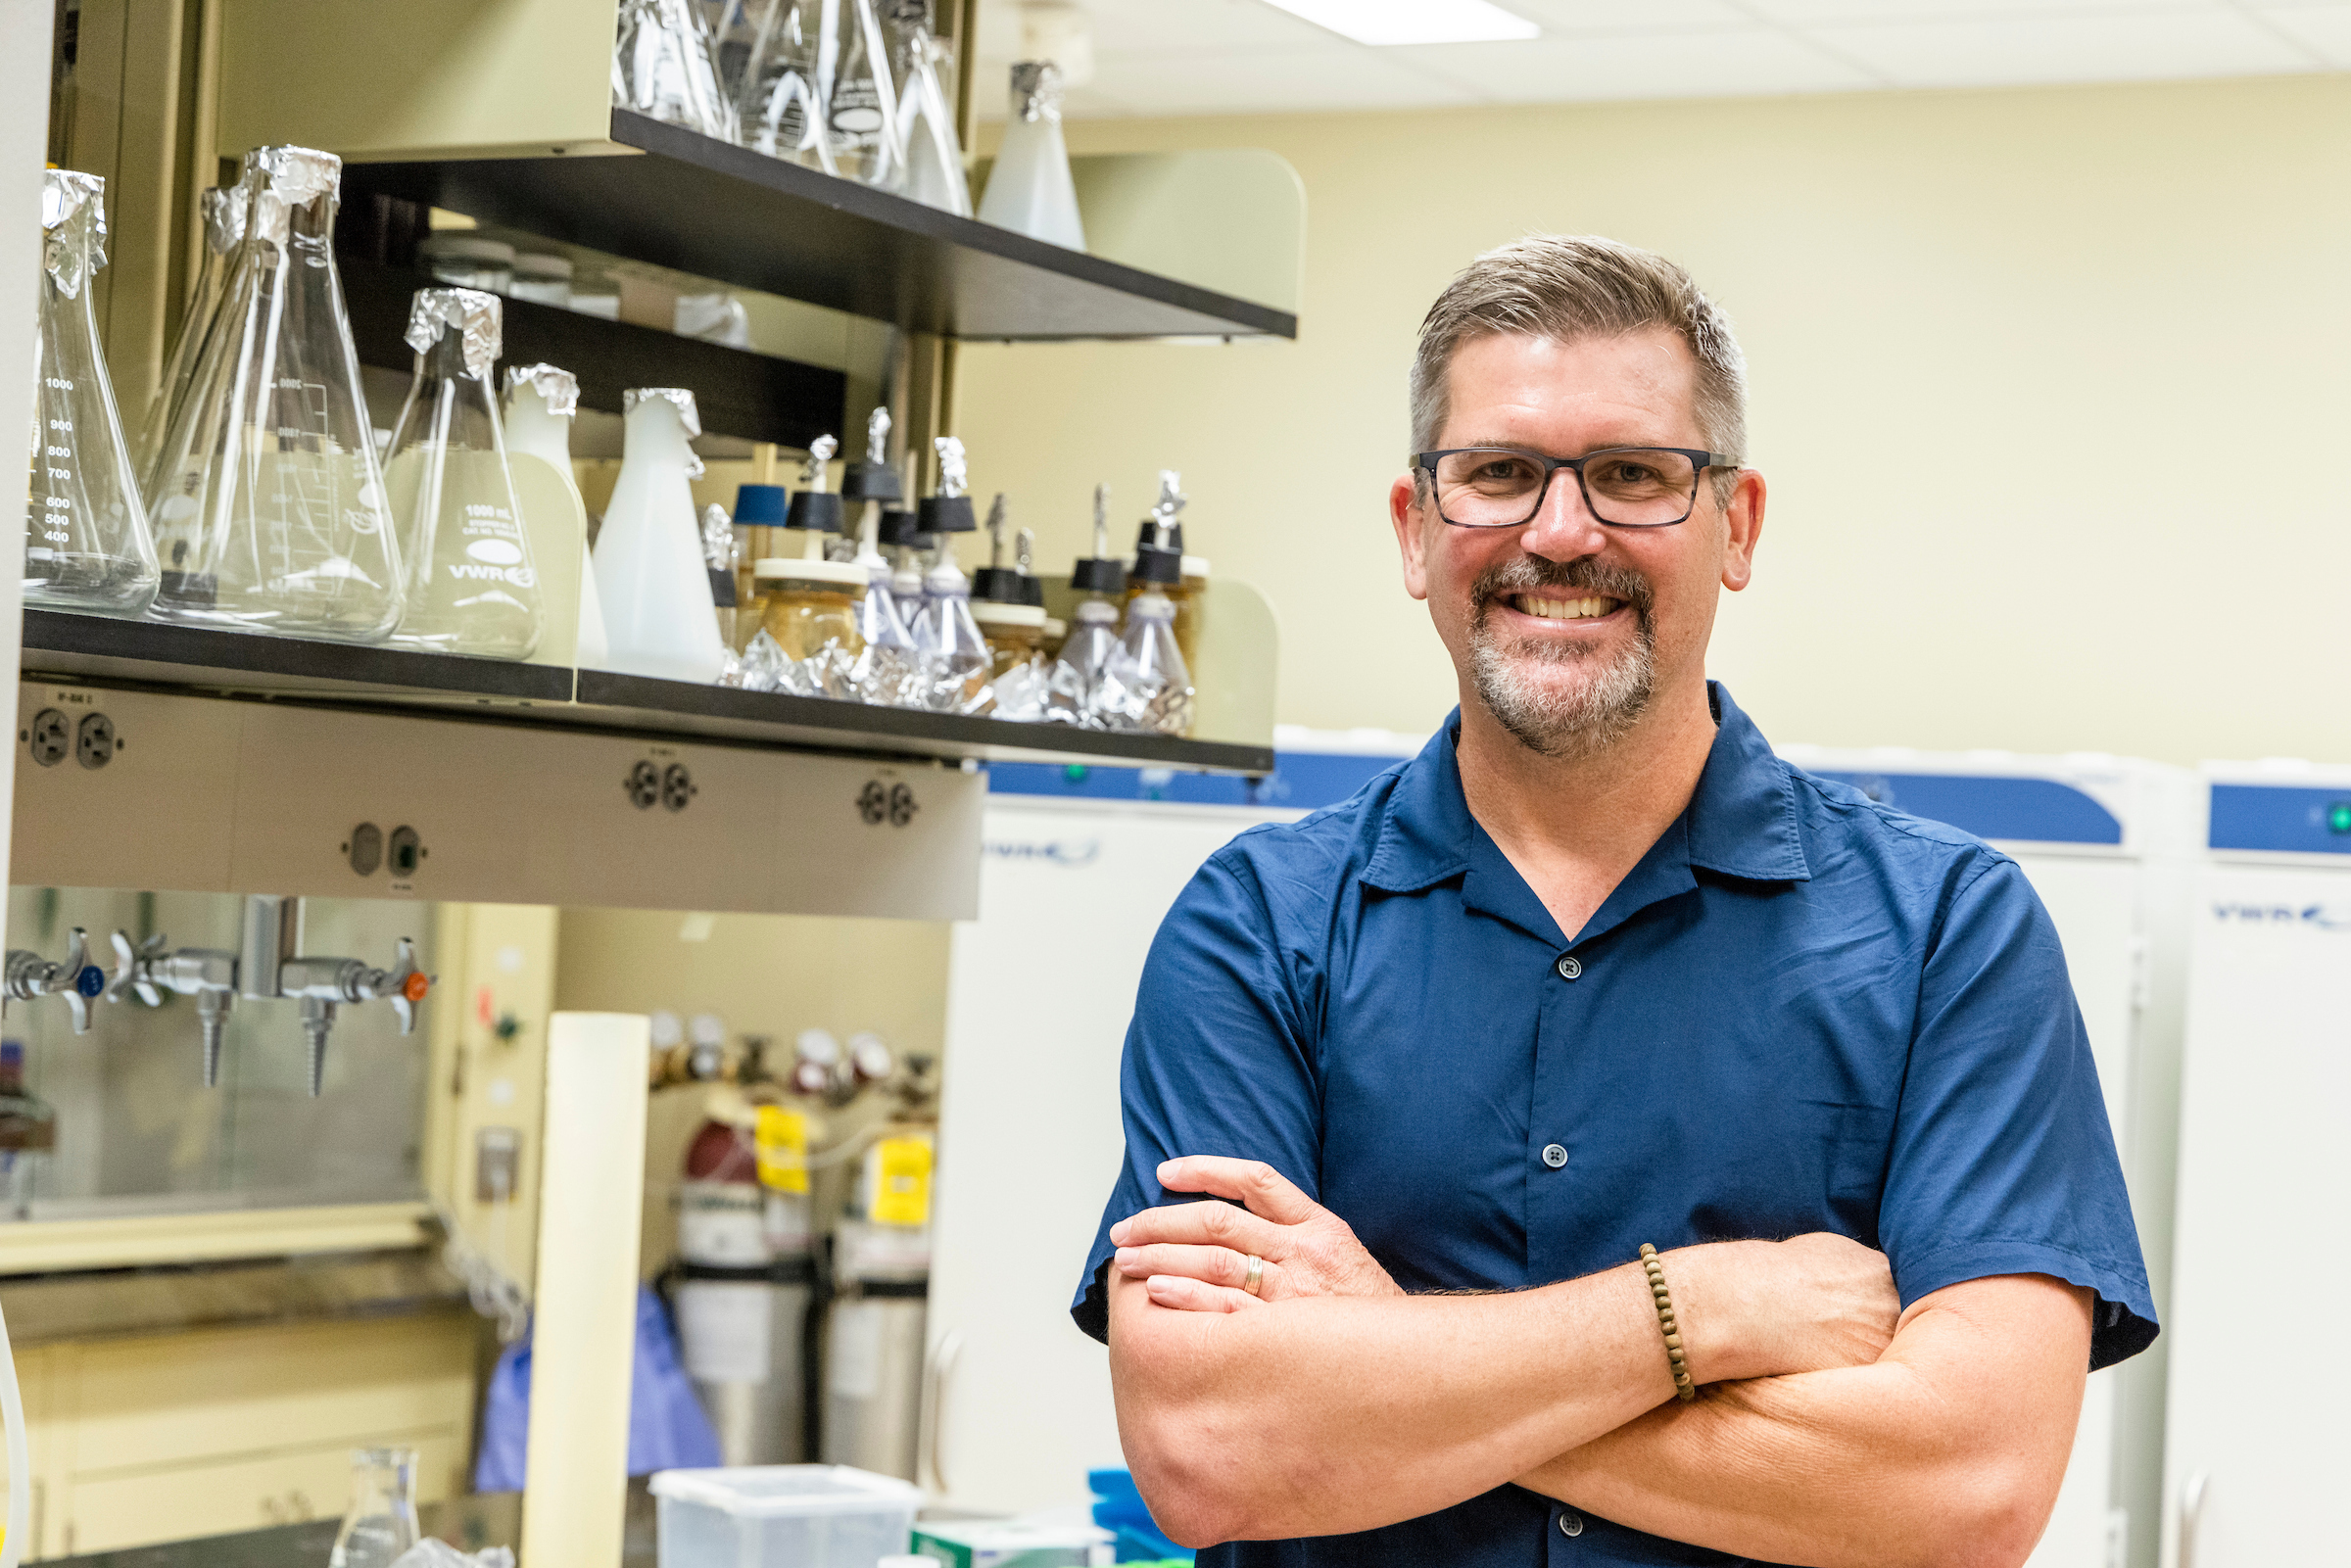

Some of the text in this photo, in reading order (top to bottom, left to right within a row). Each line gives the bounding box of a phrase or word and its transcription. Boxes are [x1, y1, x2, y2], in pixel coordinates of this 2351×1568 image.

[45, 377, 73, 391] 1000
[50, 419, 73, 432] 900
[48, 446, 72, 458] 800
[48, 467, 72, 480] 700
[46, 497, 71, 509] 600
[465, 504, 495, 517] 1000
[44, 513, 70, 526] 500
[44, 530, 70, 543] 400
[448, 564, 504, 582] VWR
